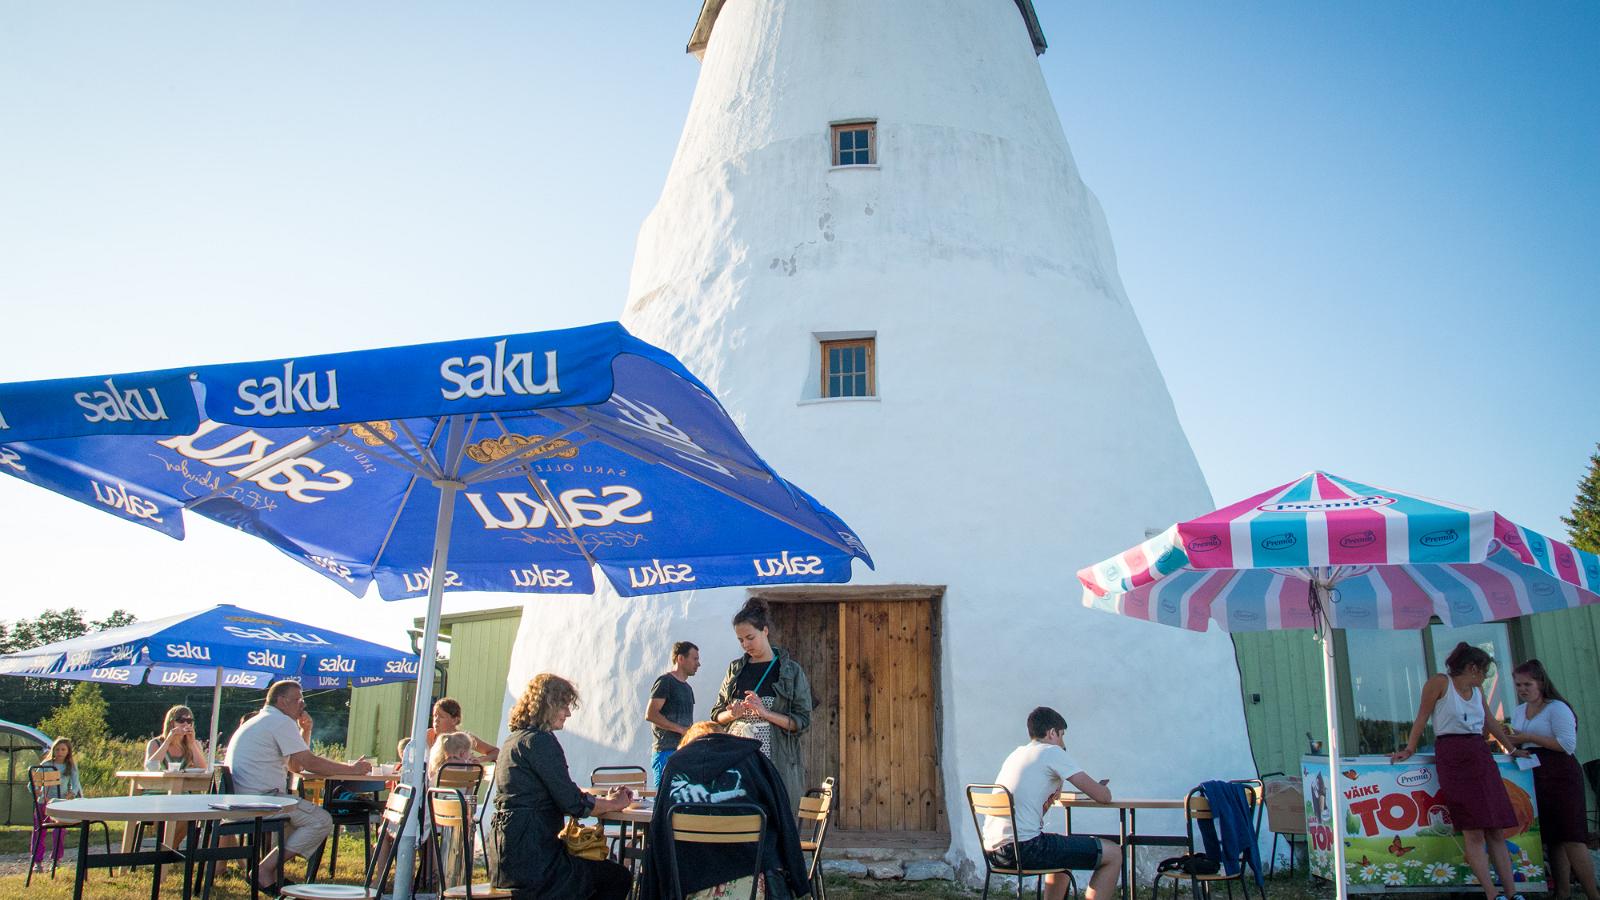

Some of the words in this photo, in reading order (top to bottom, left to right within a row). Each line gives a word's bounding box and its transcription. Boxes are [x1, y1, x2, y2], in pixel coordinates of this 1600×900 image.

[440, 338, 561, 400] saku
[233, 360, 340, 416] saku
[74, 378, 169, 422] saku
[223, 626, 332, 645] saku
[166, 641, 211, 660] saku
[247, 648, 286, 669] saku
[318, 654, 356, 673] saku
[384, 657, 418, 674] saku
[1343, 784, 1380, 800] VÄIKE
